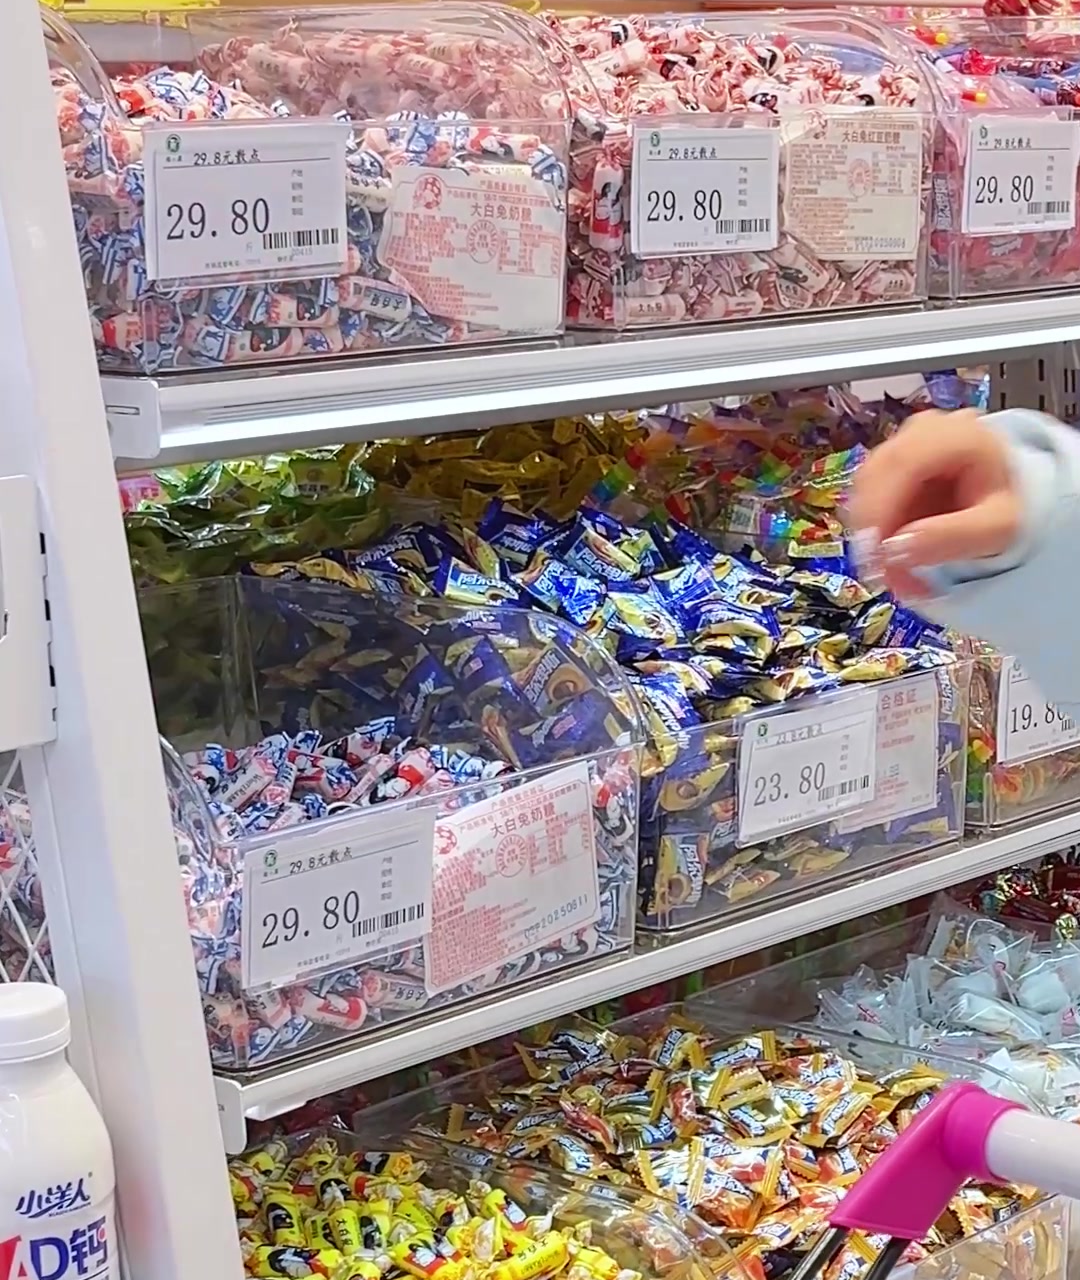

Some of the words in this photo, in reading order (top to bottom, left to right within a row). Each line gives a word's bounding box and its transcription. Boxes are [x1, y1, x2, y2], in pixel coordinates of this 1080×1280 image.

[647, 189, 722, 222] 29.80
[976, 175, 1034, 204] 29.80
[167, 198, 270, 240] 29.80
[470, 204, 532, 222] 大白兔奶糖
[753, 762, 826, 807] 23.80
[492, 803, 556, 838] 大白兔奶糖
[262, 890, 360, 949] 29.80
[15, 1177, 91, 1219] 小洋人
